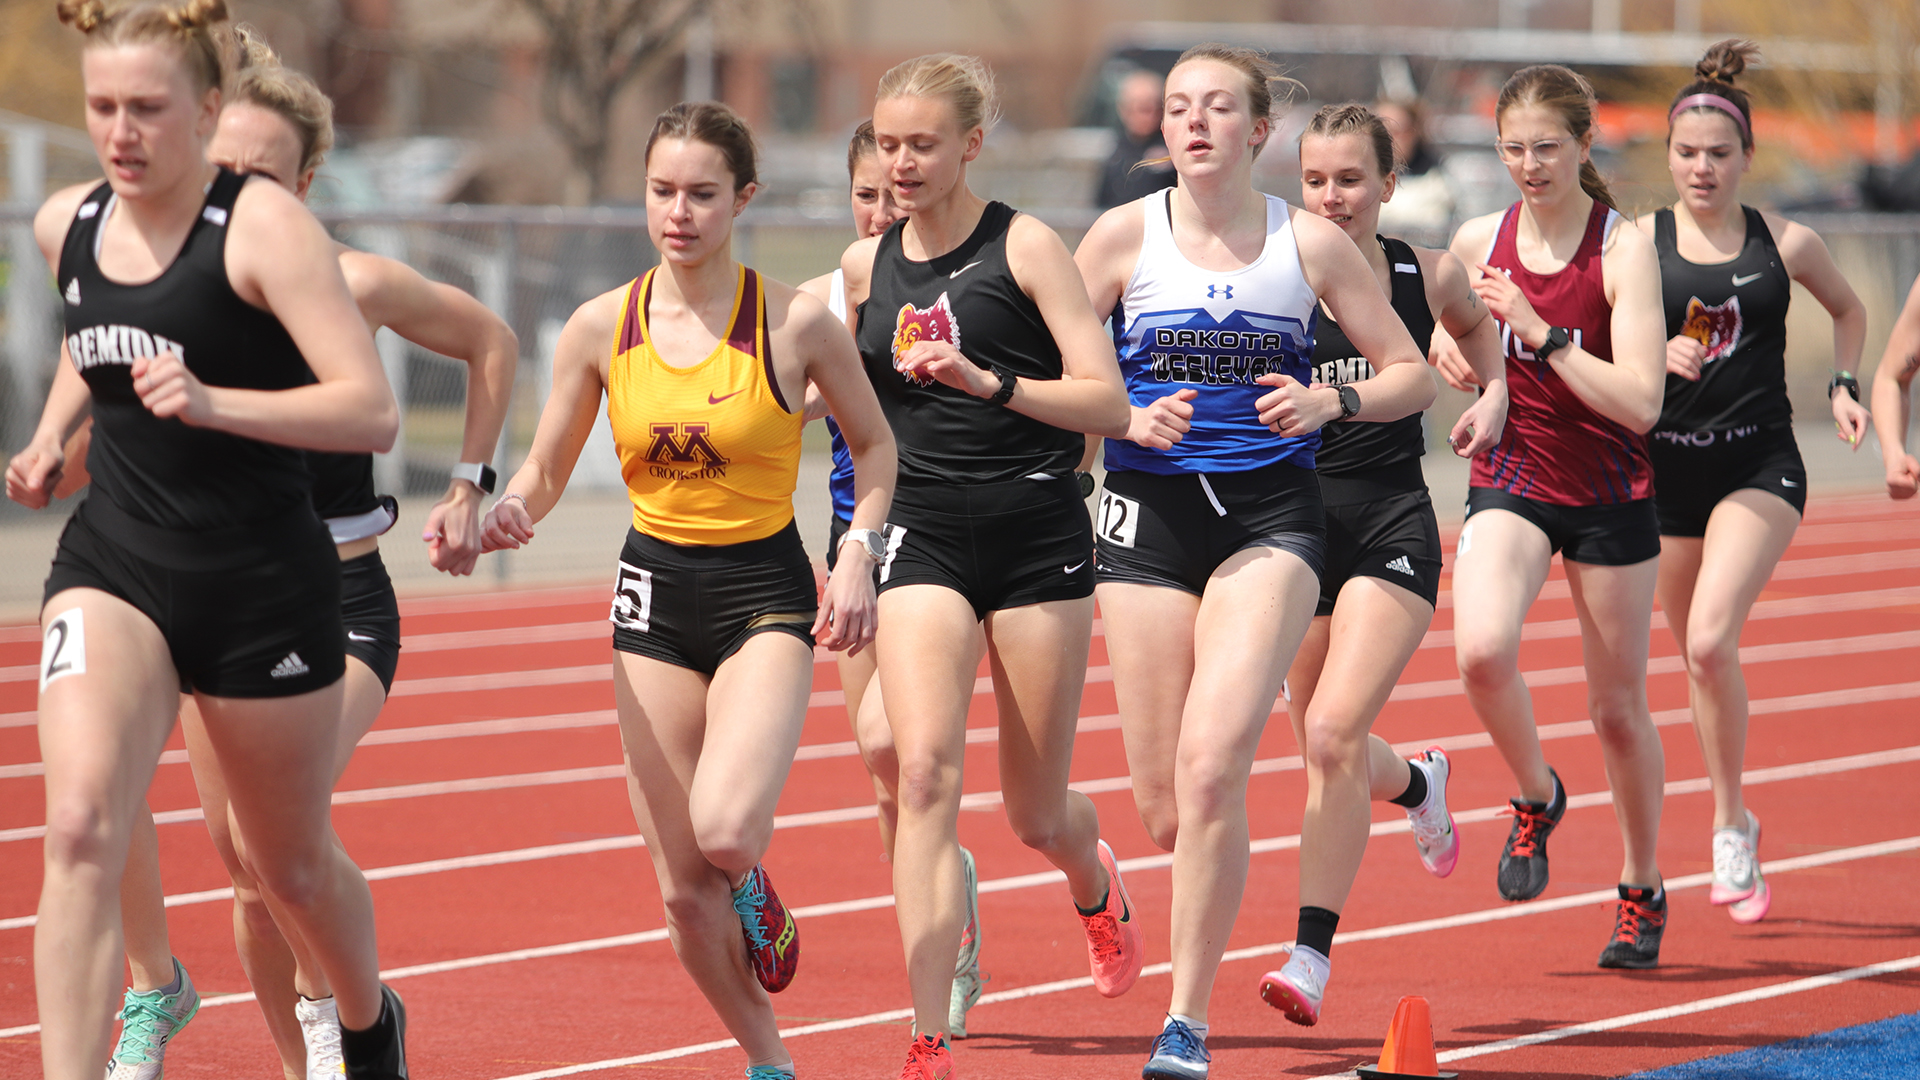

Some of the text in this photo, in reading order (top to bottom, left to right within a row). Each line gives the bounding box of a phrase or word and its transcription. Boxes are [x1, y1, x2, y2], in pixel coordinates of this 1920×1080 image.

[1156, 328, 1281, 350] DAKOTA
[642, 421, 730, 468] M
[1103, 494, 1128, 543] 12
[614, 566, 642, 624] 5
[46, 618, 72, 681] 2
[270, 664, 310, 678] adidas
